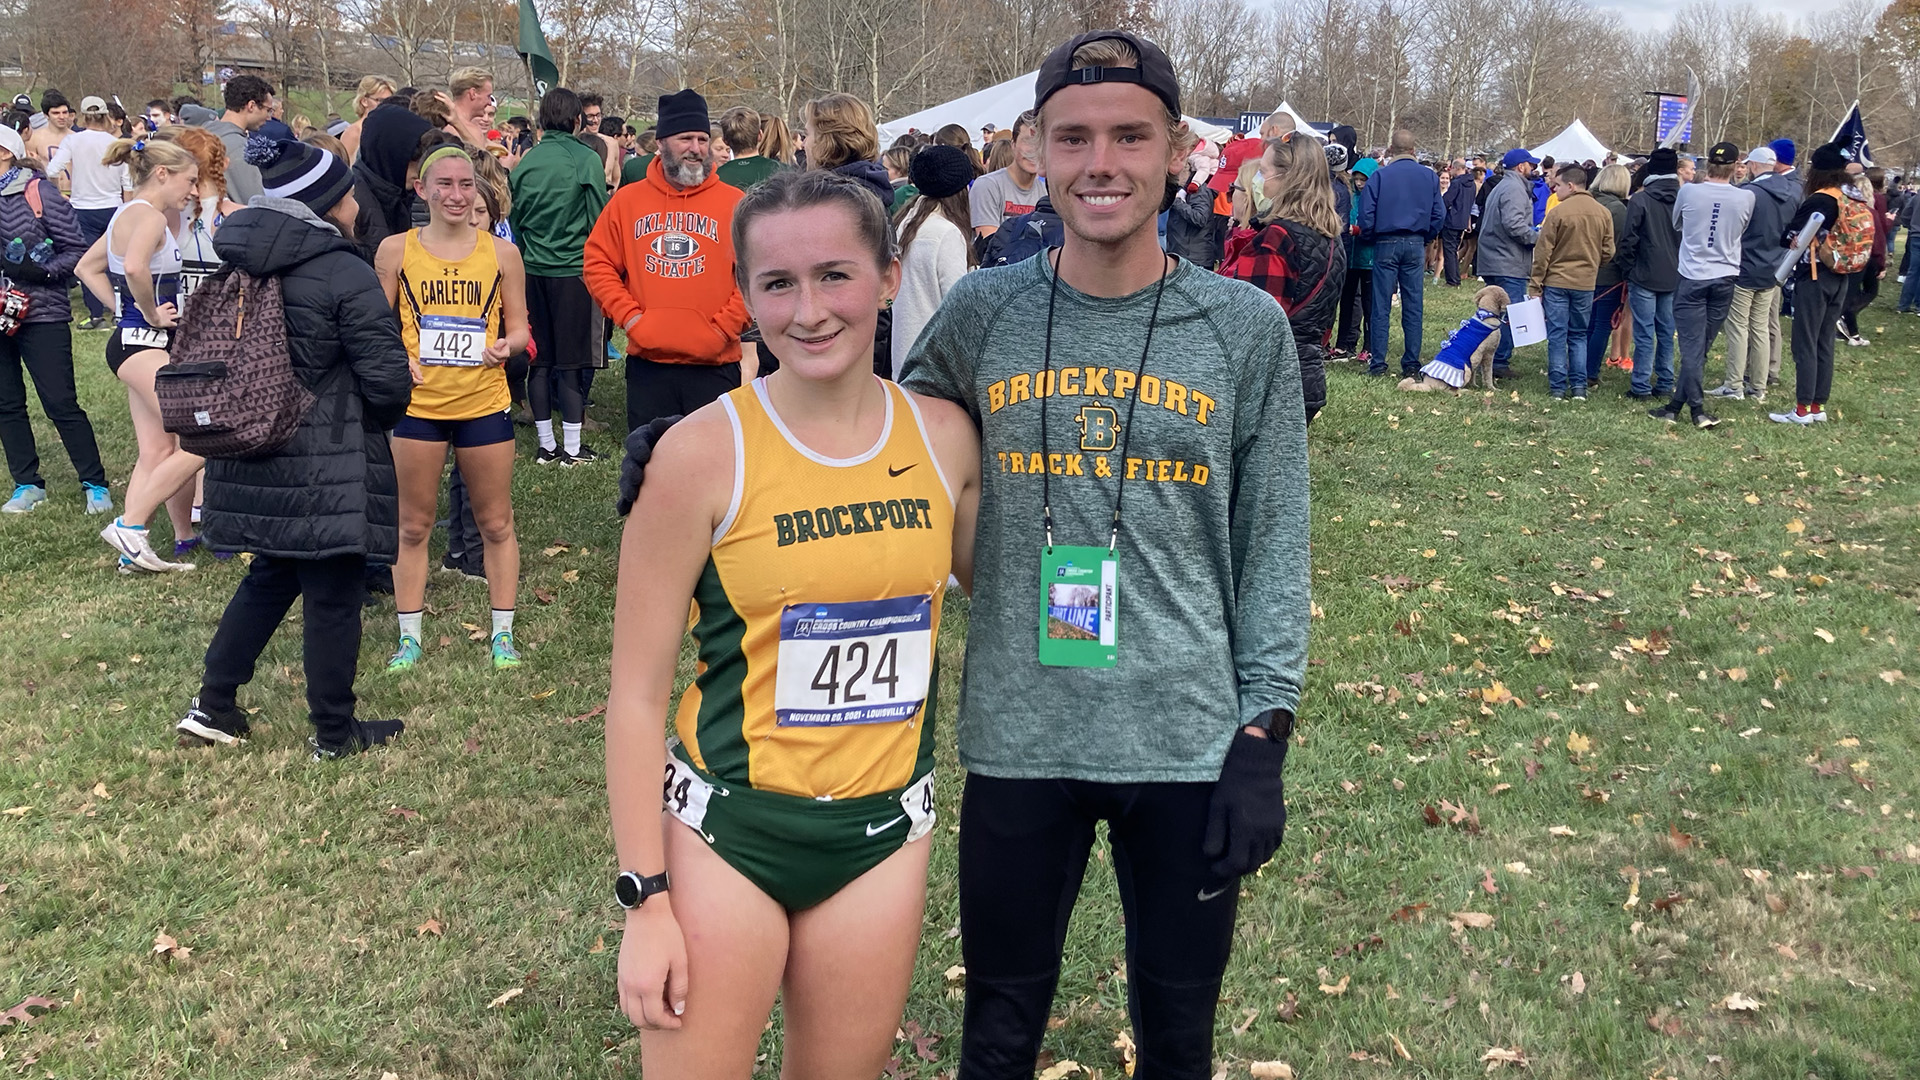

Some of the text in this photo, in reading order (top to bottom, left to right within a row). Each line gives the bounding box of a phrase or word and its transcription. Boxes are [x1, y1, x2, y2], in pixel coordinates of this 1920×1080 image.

[634, 212, 720, 243] OKLAHOMA
[671, 242, 681, 251] 16
[645, 254, 706, 278] STATE
[420, 280, 482, 306] CARLETON
[131, 328, 160, 343] 477
[433, 332, 473, 359] 442
[986, 366, 1216, 426] BROCKPORT
[1077, 402, 1120, 451] B
[998, 451, 1210, 486] TRACK & FIELD
[773, 498, 933, 548] BROCKPORT
[1104, 583, 1113, 622] PARTICIPANT
[838, 619, 869, 631] COUNTRY
[1067, 608, 1098, 631] LINE
[810, 638, 899, 705] 424
[789, 712, 831, 723] NOVEMBER
[844, 710, 861, 721] 2021
